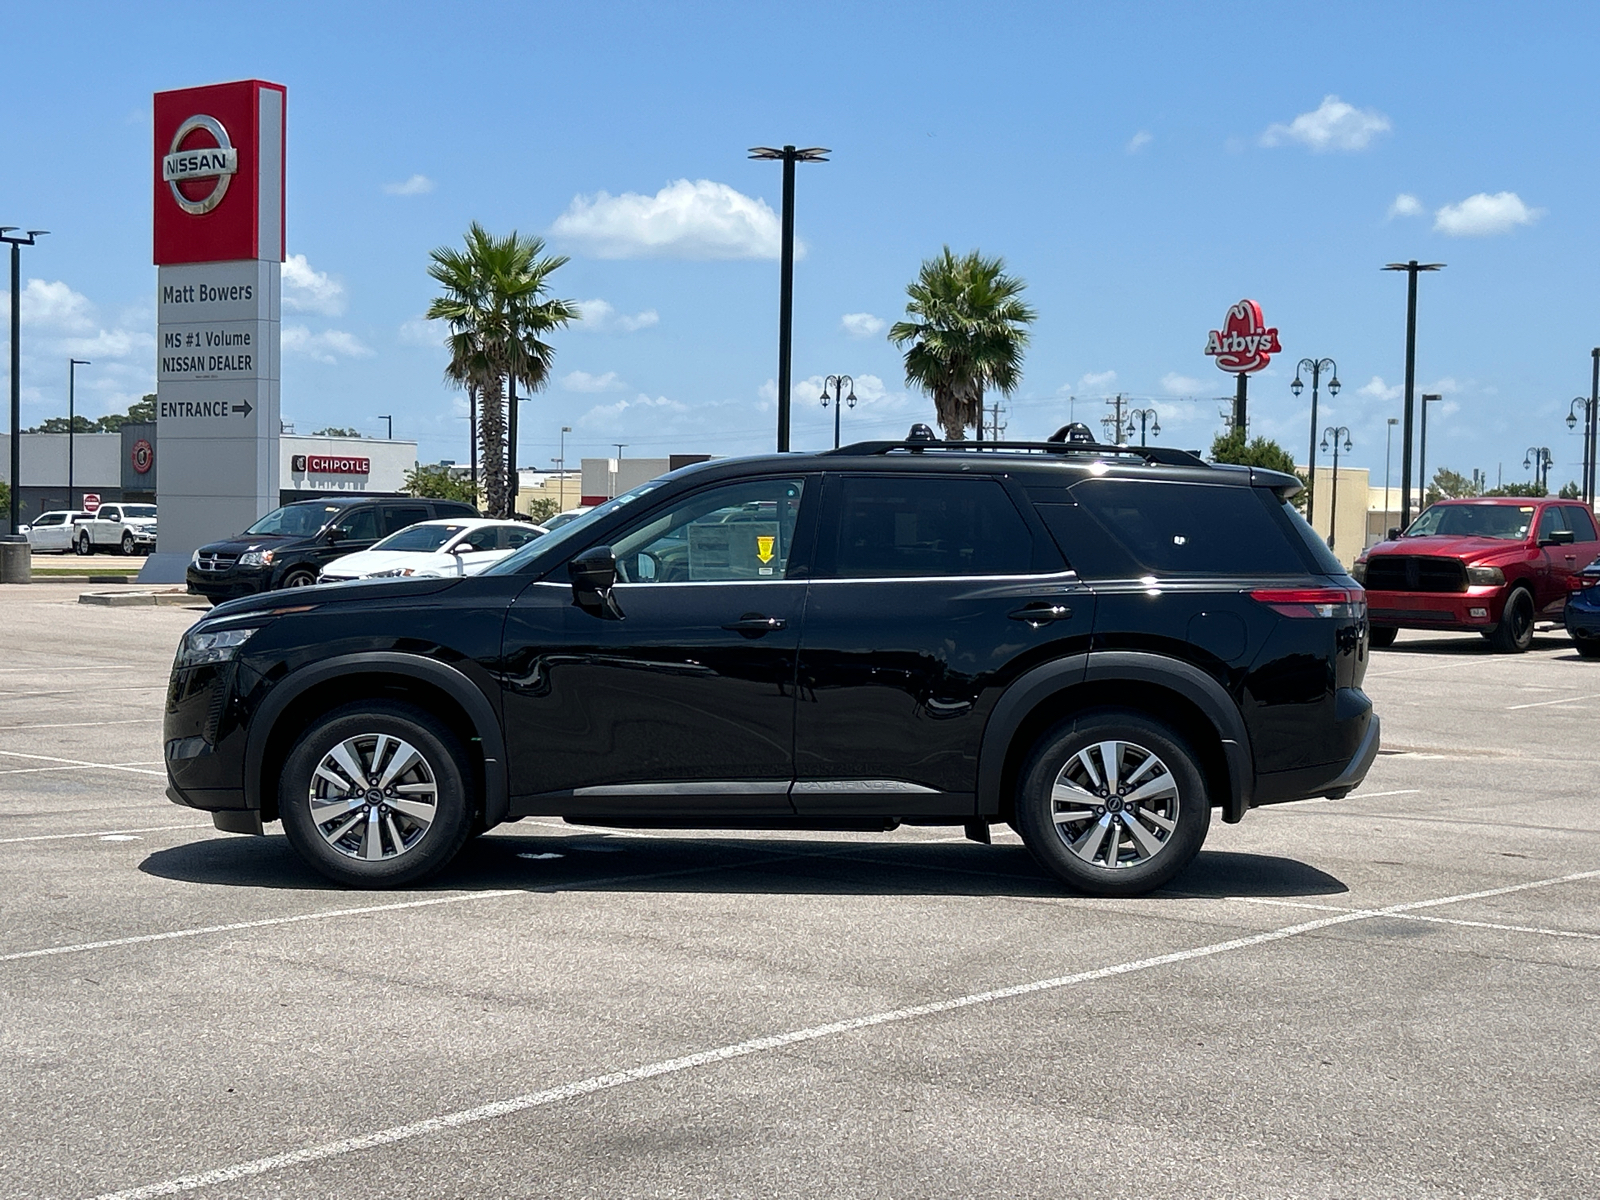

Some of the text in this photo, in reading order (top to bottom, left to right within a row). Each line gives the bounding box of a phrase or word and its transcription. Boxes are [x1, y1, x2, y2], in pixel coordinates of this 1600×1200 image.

[167, 154, 226, 175] NISSAN
[163, 284, 253, 304] Matt Bowers
[165, 330, 251, 348] MS #1 Volume
[1204, 328, 1273, 357] Arby's
[162, 355, 252, 372] NISSAN DEALER
[161, 401, 228, 417] ENTRANCE
[312, 459, 369, 472] CHIPOTLE
[800, 781, 908, 790] PATHFINDER
